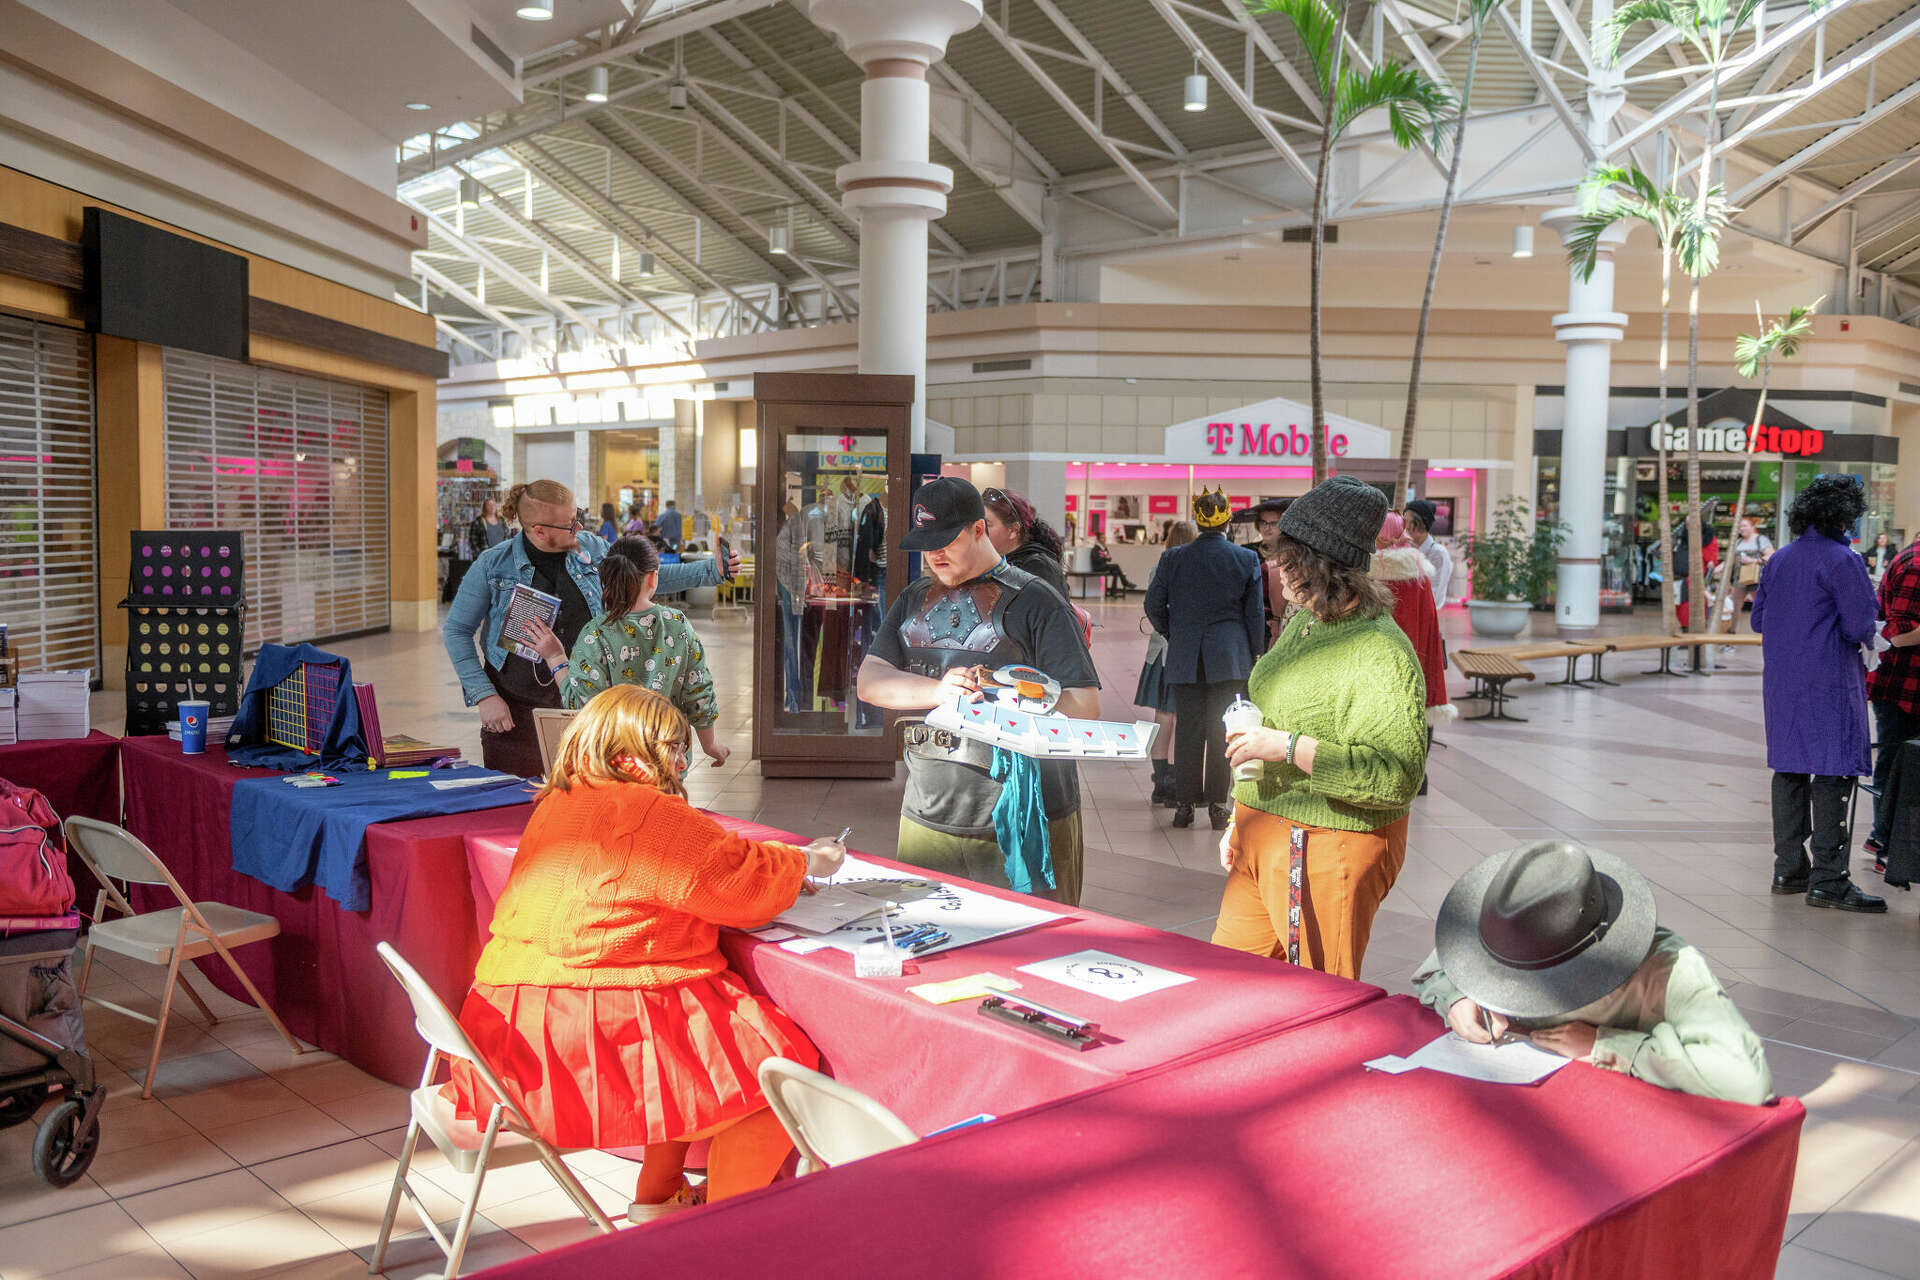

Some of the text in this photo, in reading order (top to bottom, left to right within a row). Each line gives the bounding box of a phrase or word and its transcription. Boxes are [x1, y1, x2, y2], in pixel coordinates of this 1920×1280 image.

[1207, 422, 1349, 457] T Moble
[1650, 421, 1824, 457] GameStop
